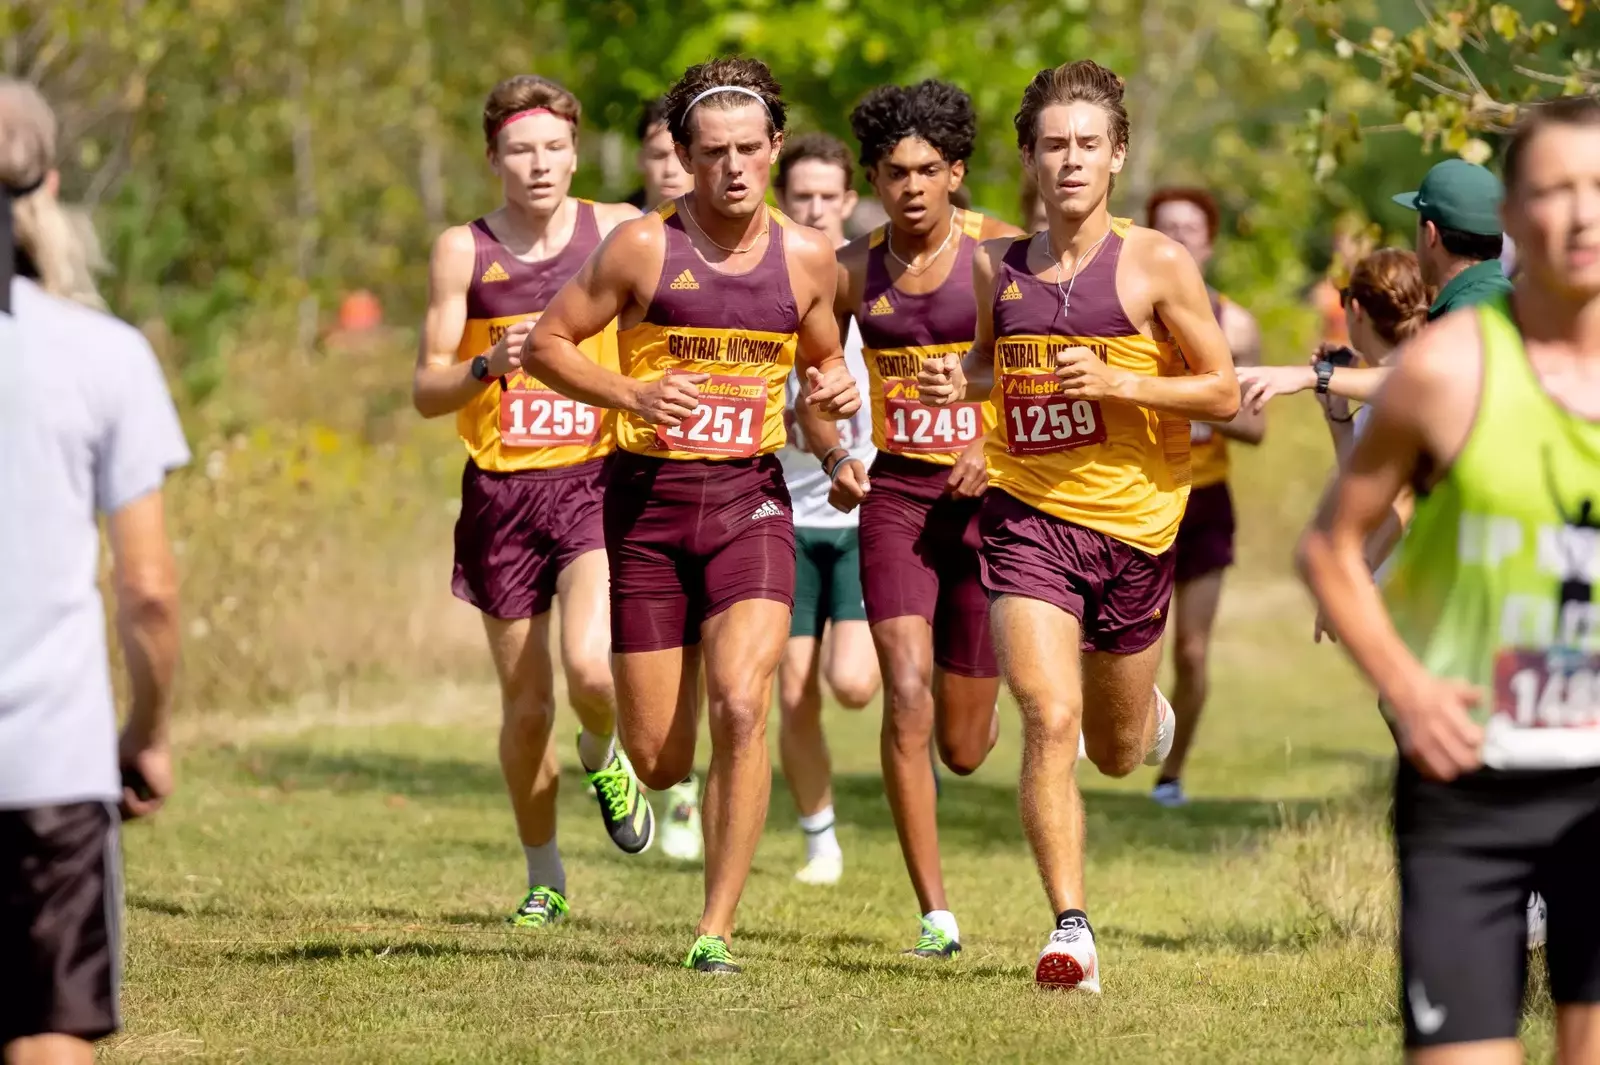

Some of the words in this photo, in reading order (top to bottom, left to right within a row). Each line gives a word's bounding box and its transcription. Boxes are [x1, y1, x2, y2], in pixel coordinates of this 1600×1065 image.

[670, 281, 699, 290] adidas
[668, 334, 721, 361] CENTRAL
[727, 337, 784, 363] MICHIGAN
[998, 343, 1041, 368] CENTRAL
[696, 377, 740, 396] hletic
[742, 387, 760, 396] NET
[509, 398, 595, 436] 1255
[893, 406, 976, 443] 1249
[1011, 400, 1096, 442] 1259
[752, 510, 784, 520] adidas
